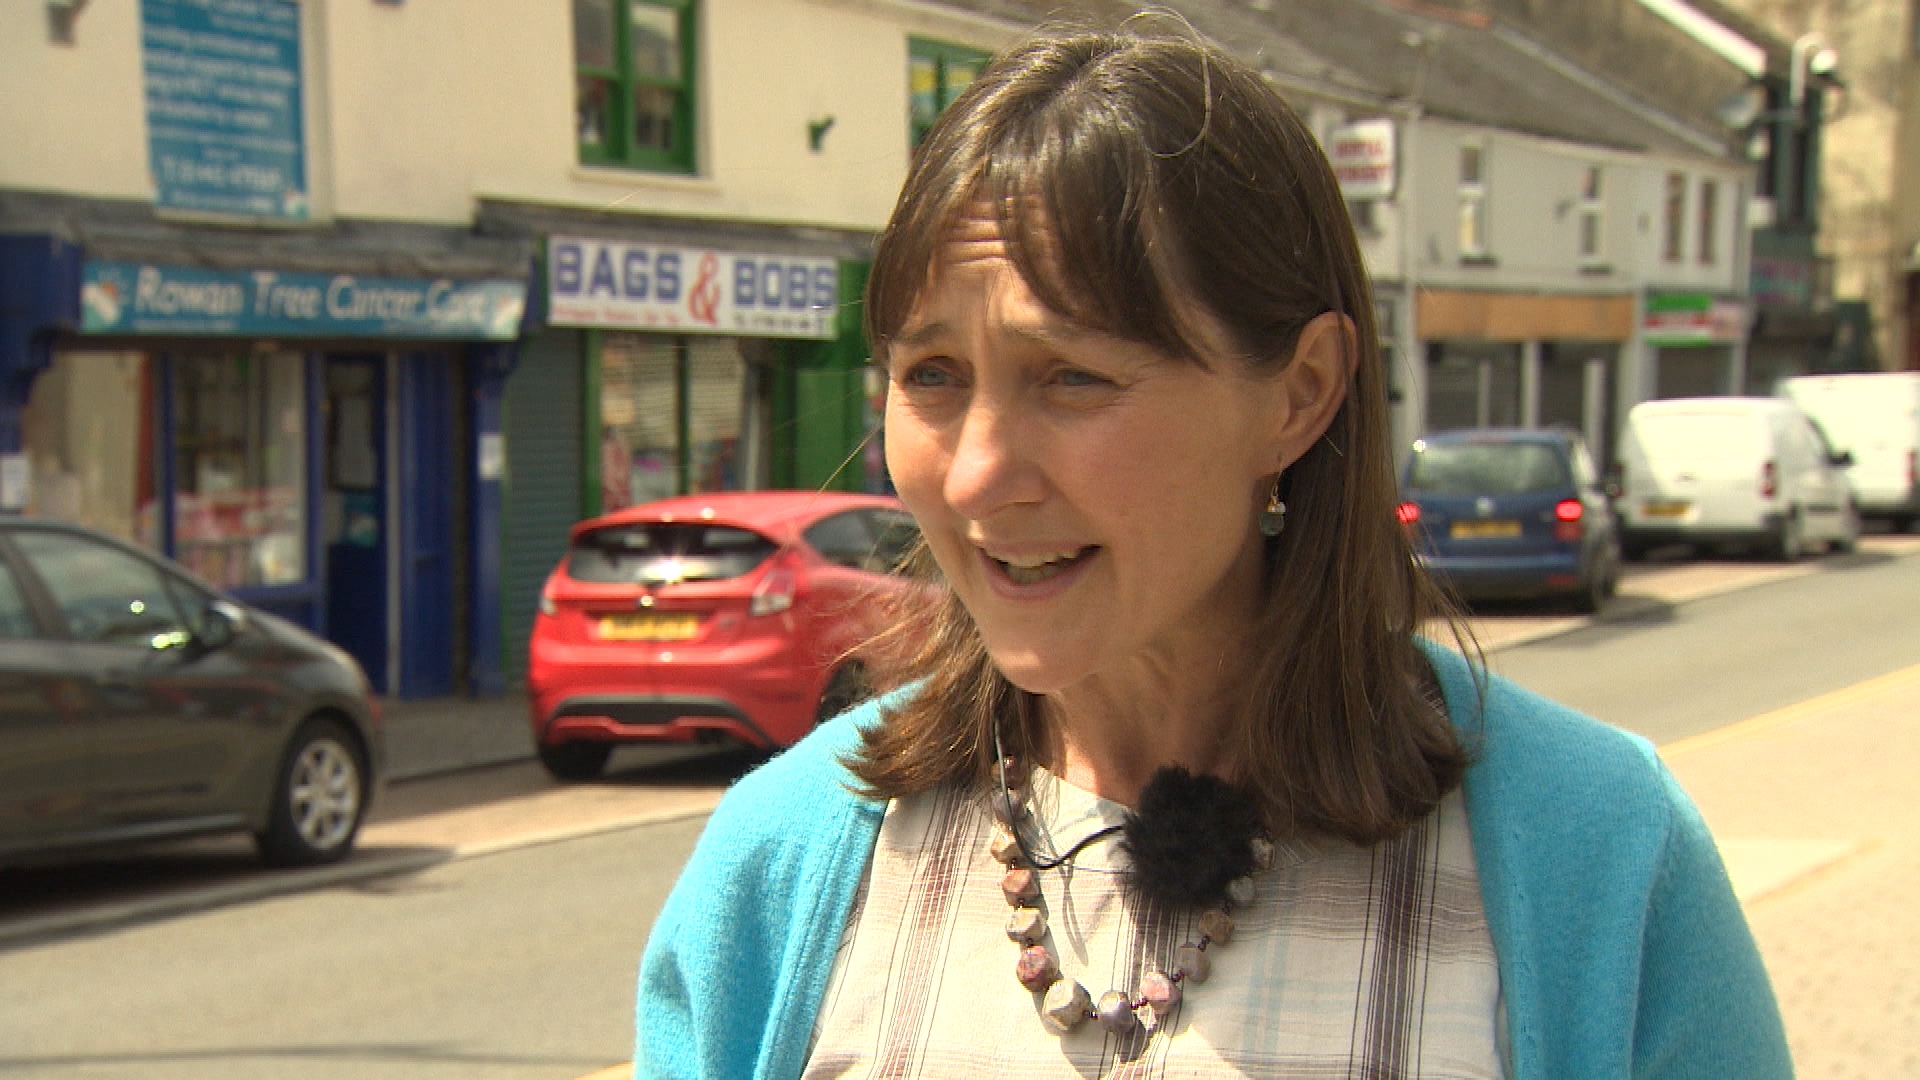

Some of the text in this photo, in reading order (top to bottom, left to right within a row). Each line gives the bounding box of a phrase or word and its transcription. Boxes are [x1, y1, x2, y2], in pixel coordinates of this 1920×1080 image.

[134, 264, 487, 322] Rowan Tree Cancer Care
[554, 244, 682, 301] BAGS
[688, 251, 722, 327] &
[734, 259, 835, 311] BOBS
